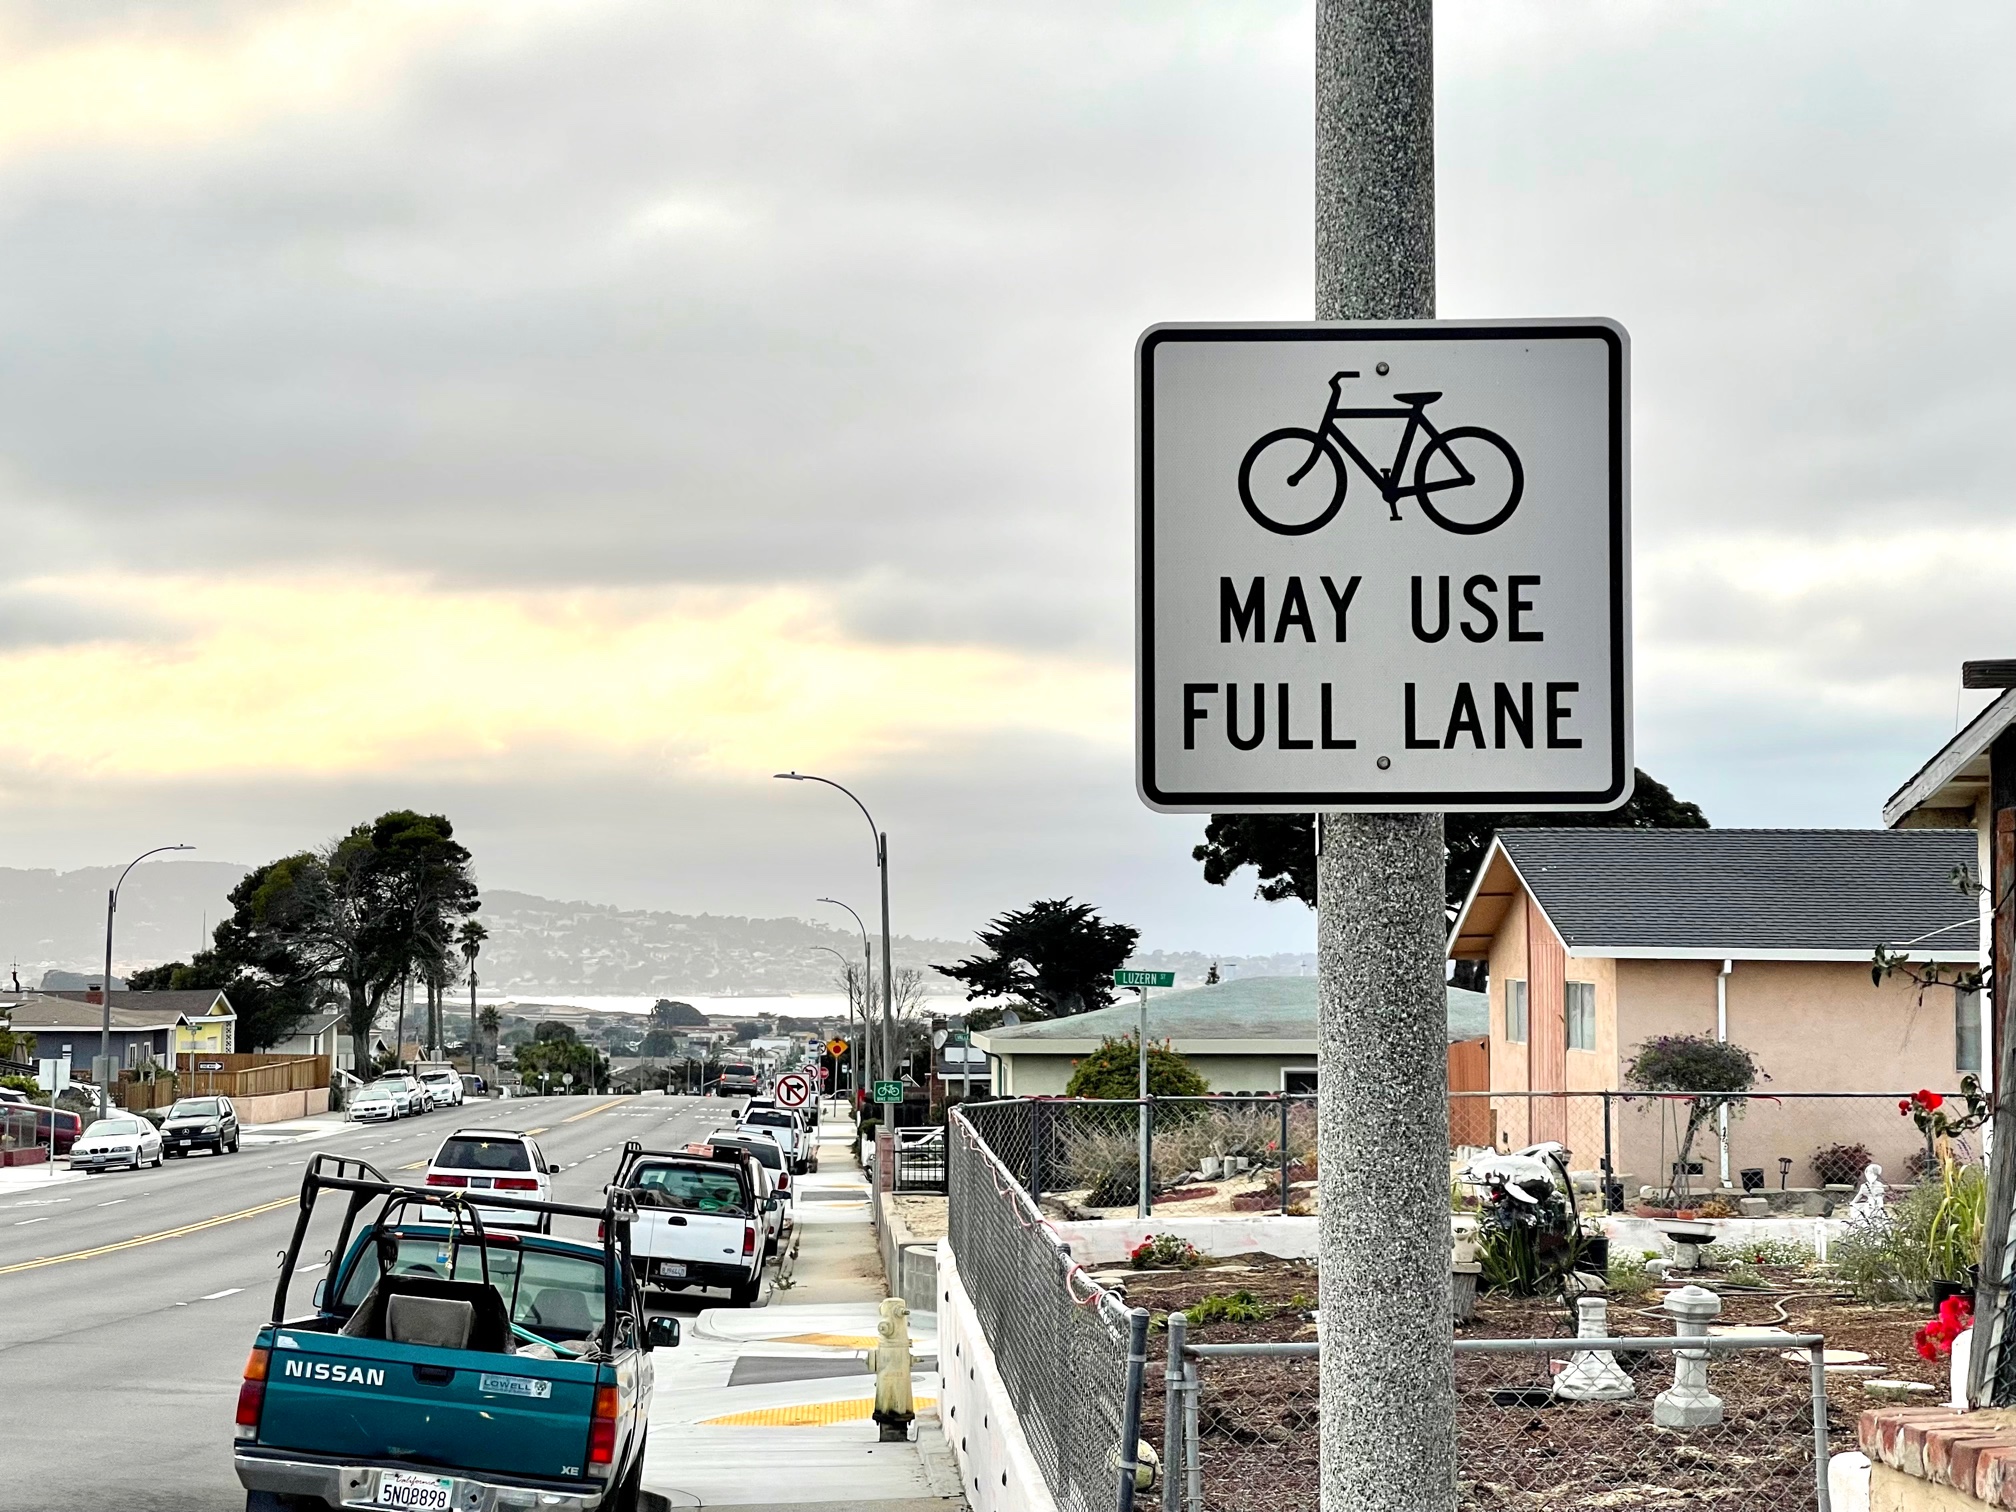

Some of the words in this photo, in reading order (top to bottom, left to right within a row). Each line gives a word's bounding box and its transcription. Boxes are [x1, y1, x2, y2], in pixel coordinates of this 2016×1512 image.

[1220, 575, 1363, 643] MAY
[1411, 574, 1544, 643] USE
[1183, 682, 1357, 750] FULL
[1404, 681, 1583, 750] LANE
[1122, 972, 1157, 985] LUZERN
[285, 1360, 385, 1386] NISSAN
[484, 1379, 531, 1391] LOWELL
[561, 1465, 579, 1476] XE
[396, 1474, 440, 1487] California
